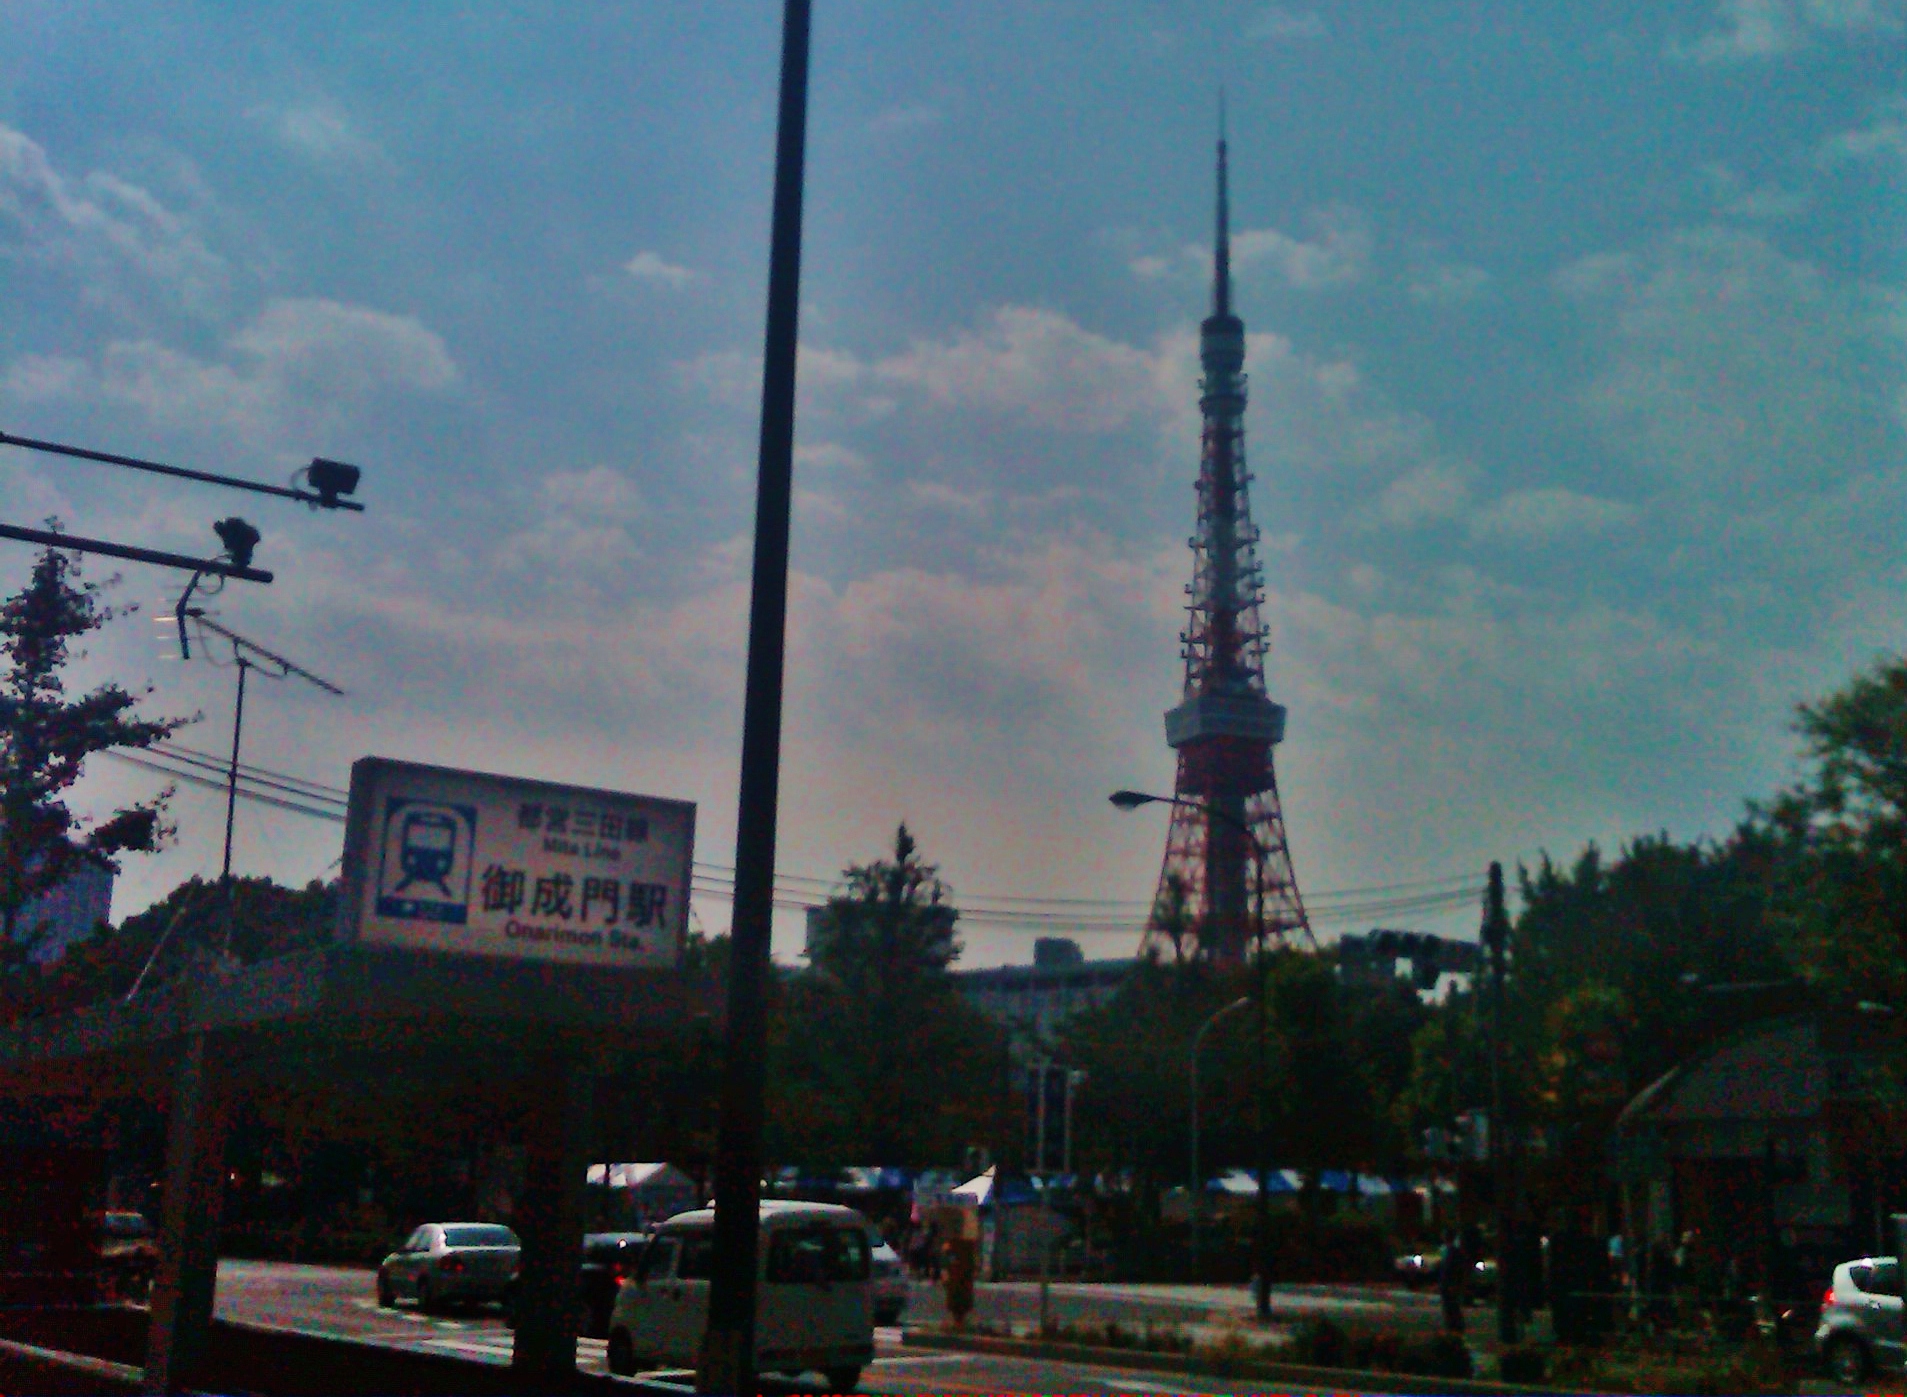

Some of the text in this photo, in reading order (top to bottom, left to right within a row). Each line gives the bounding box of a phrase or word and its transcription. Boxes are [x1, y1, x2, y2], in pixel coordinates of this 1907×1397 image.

[482, 863, 668, 929] 御成門駅
[505, 919, 603, 946] Onarimon
